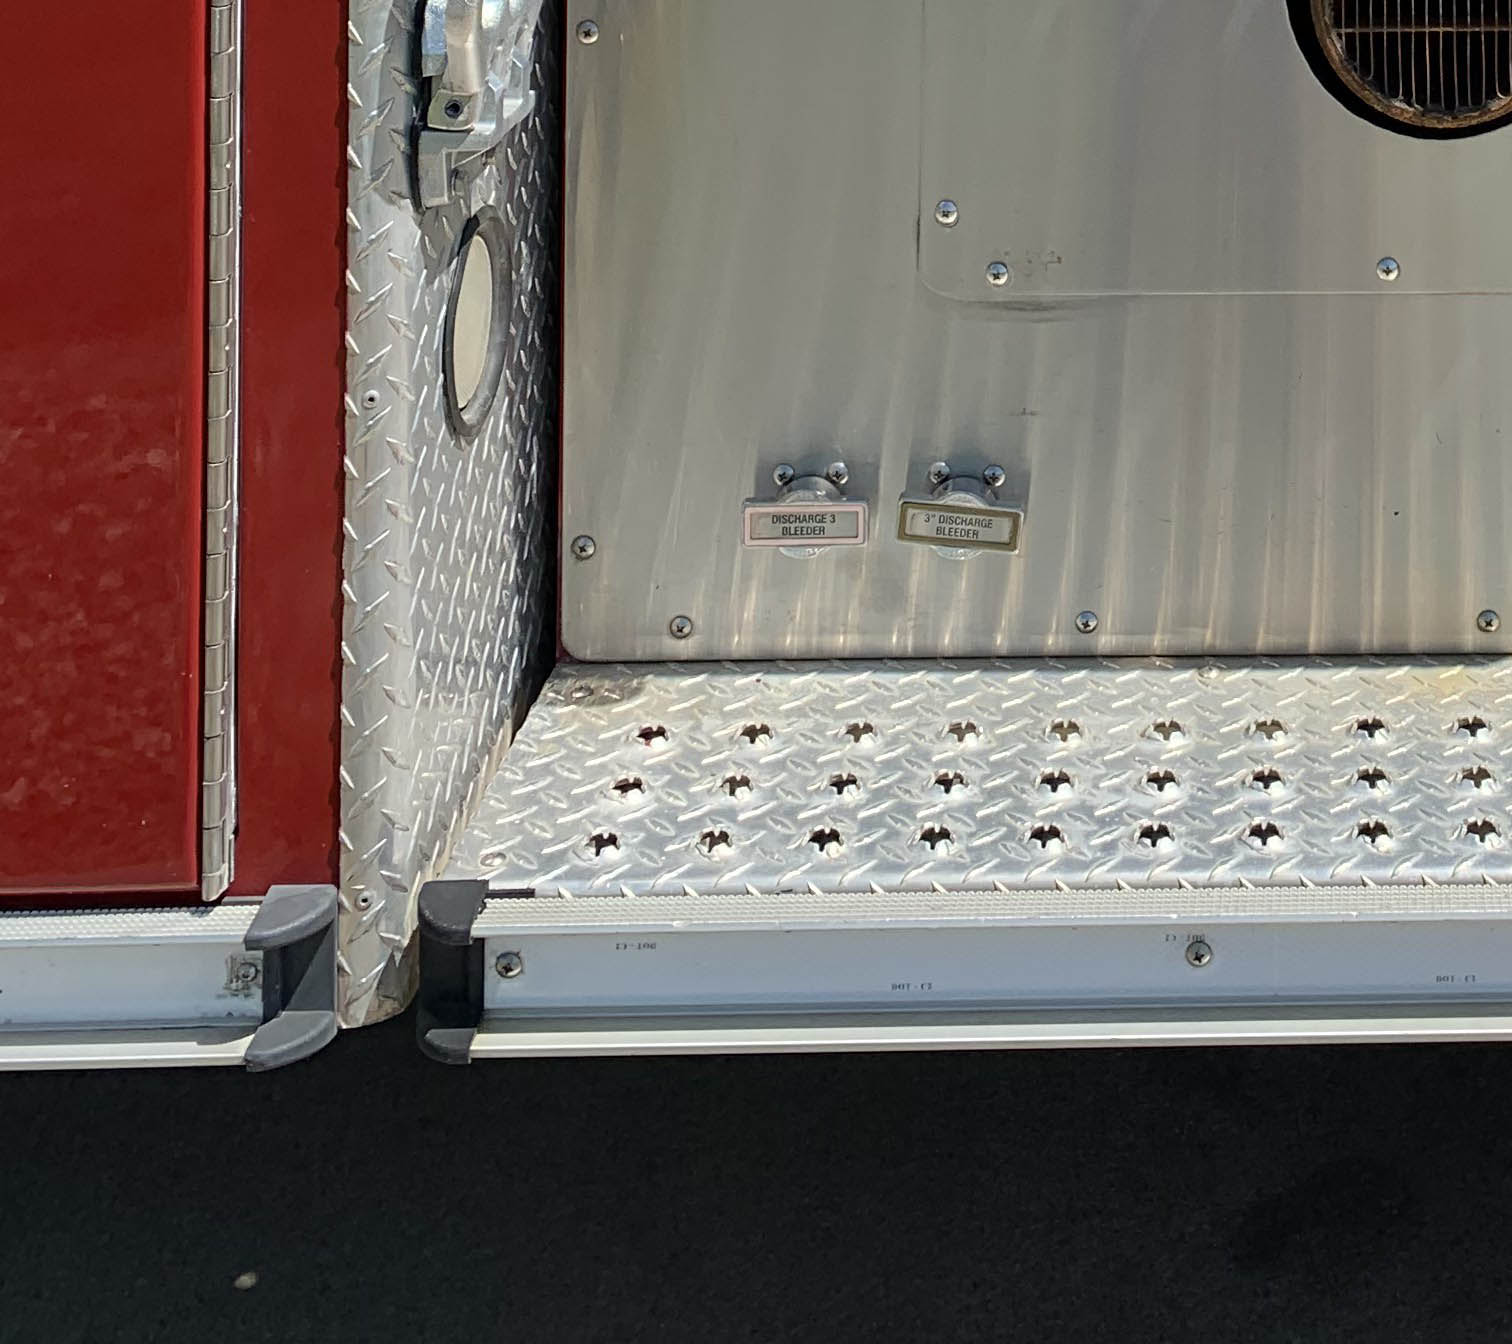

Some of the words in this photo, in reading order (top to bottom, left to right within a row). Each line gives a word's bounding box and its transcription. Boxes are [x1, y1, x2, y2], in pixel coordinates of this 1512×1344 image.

[771, 514, 828, 525] DISCHARGE
[829, 514, 837, 524] 3
[924, 513, 937, 523] 3"
[938, 514, 994, 529] DISCHARGE
[781, 526, 826, 536] BLEEDER
[936, 526, 980, 540] BLEEDER
